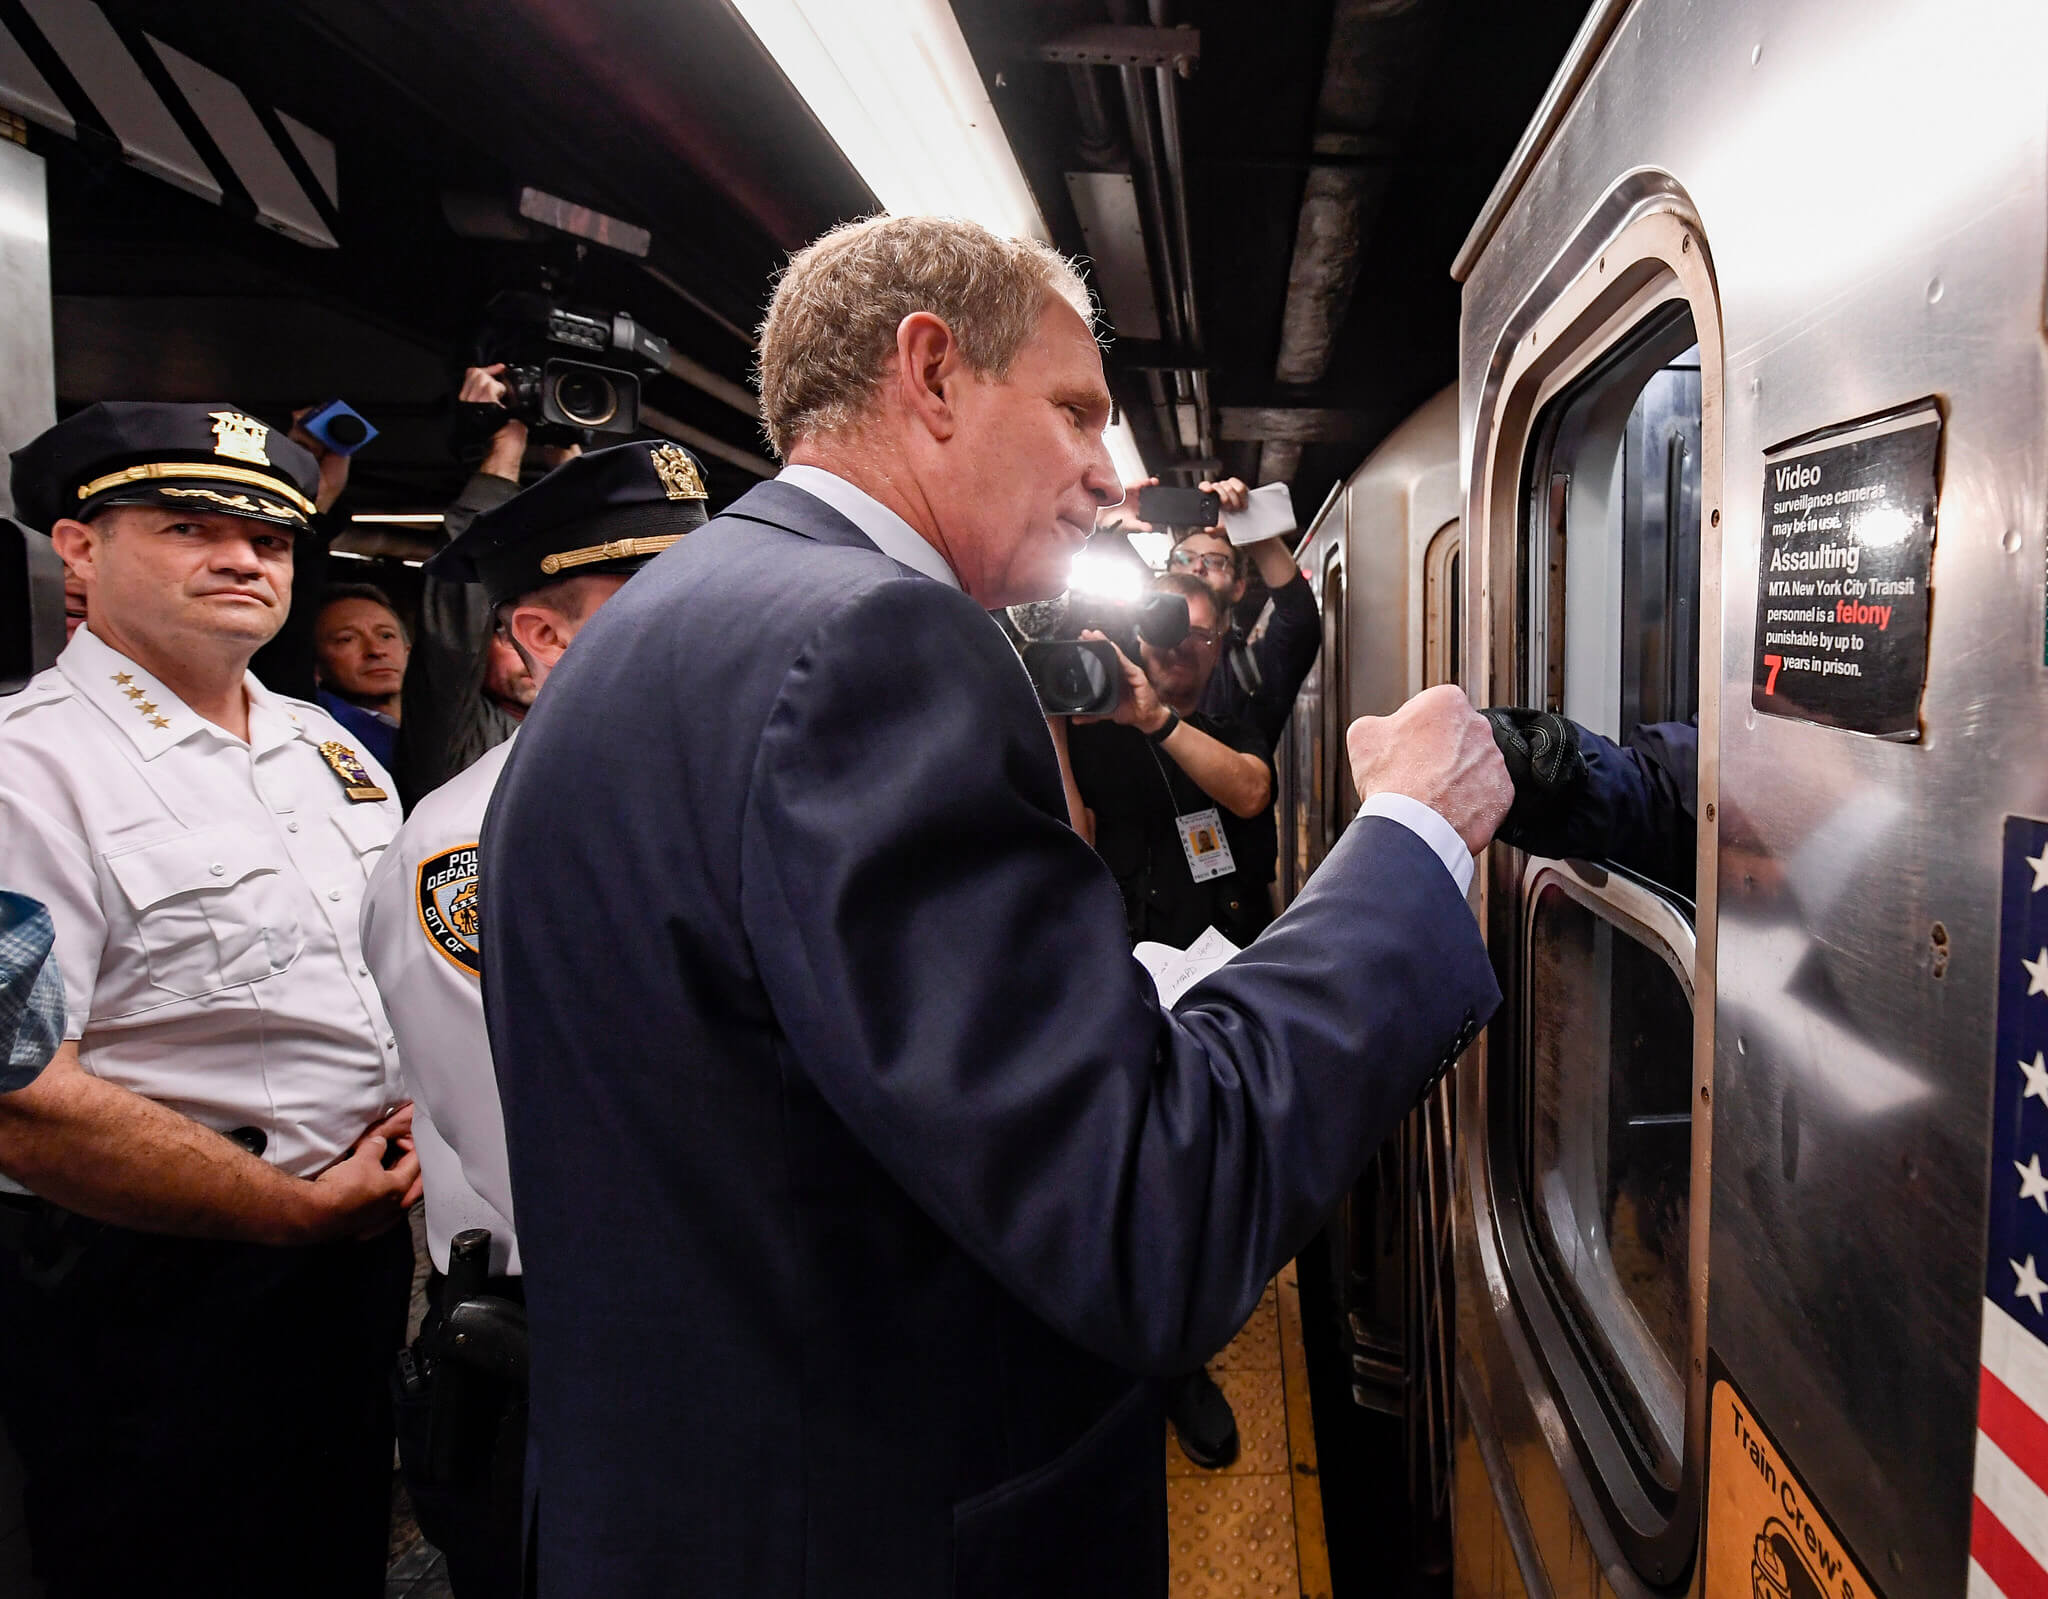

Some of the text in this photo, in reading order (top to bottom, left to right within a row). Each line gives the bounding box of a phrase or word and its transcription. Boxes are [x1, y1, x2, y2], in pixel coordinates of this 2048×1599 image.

[1775, 463, 1821, 492] Video
[1773, 484, 1886, 514] surveillance cameras
[1772, 521, 1793, 538] may
[1793, 519, 1807, 534] be
[1807, 515, 1818, 531] in
[1769, 542, 1860, 574] Assaulting
[1768, 577, 1915, 599] MTA New York City Transit
[1767, 599, 1892, 631] personnel is a felony
[1765, 629, 1864, 653] punishable by up to
[1763, 654, 1862, 696] 7 years in prison.
[449, 850, 479, 868] POL
[426, 862, 478, 891] DEPAR
[425, 906, 467, 954] CITY OF
[1731, 1401, 1777, 1495] Train
